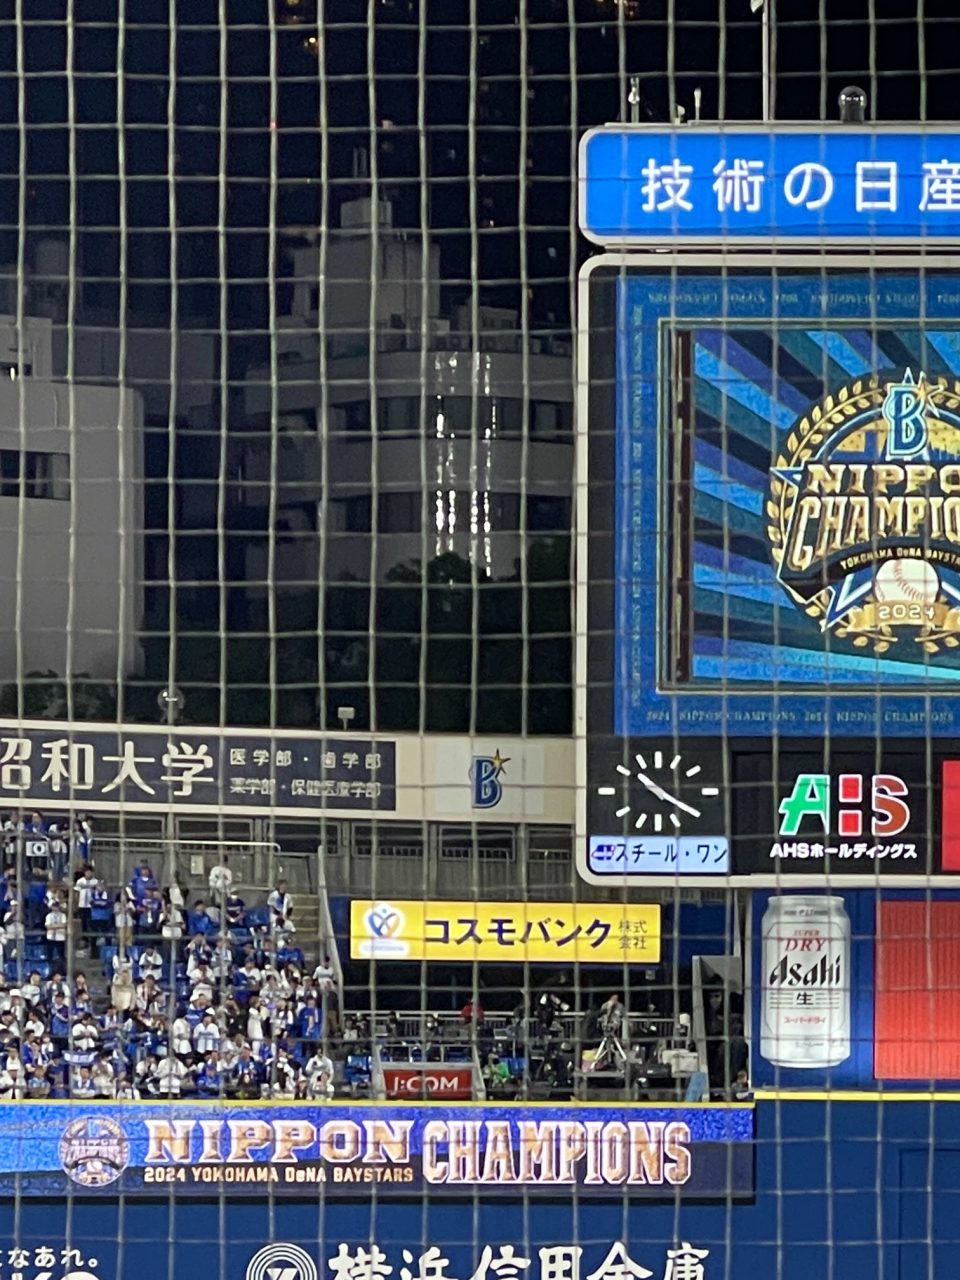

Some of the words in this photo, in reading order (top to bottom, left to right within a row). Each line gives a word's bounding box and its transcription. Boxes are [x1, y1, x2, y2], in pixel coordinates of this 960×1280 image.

[840, 548, 893, 570] YOKOHAMA
[878, 604, 936, 619] 2024
[615, 843, 728, 863] スチール・ワン
[769, 843, 918, 859] AHSホールディングス
[424, 918, 611, 949] コスモバンク
[618, 920, 647, 934] 株式
[618, 935, 647, 950] 会社
[769, 955, 841, 987] Asahi
[796, 991, 814, 1006] 生
[144, 1119, 415, 1163] NIPPON
[422, 1120, 692, 1185] CHAMPIONS
[144, 1166, 185, 1183] 2024
[192, 1167, 278, 1183] YOKOHAMA
[285, 1167, 327, 1183] DeNA
[333, 1167, 413, 1183] BAYSTARS
[0, 1246, 98, 1269] なあれ。
